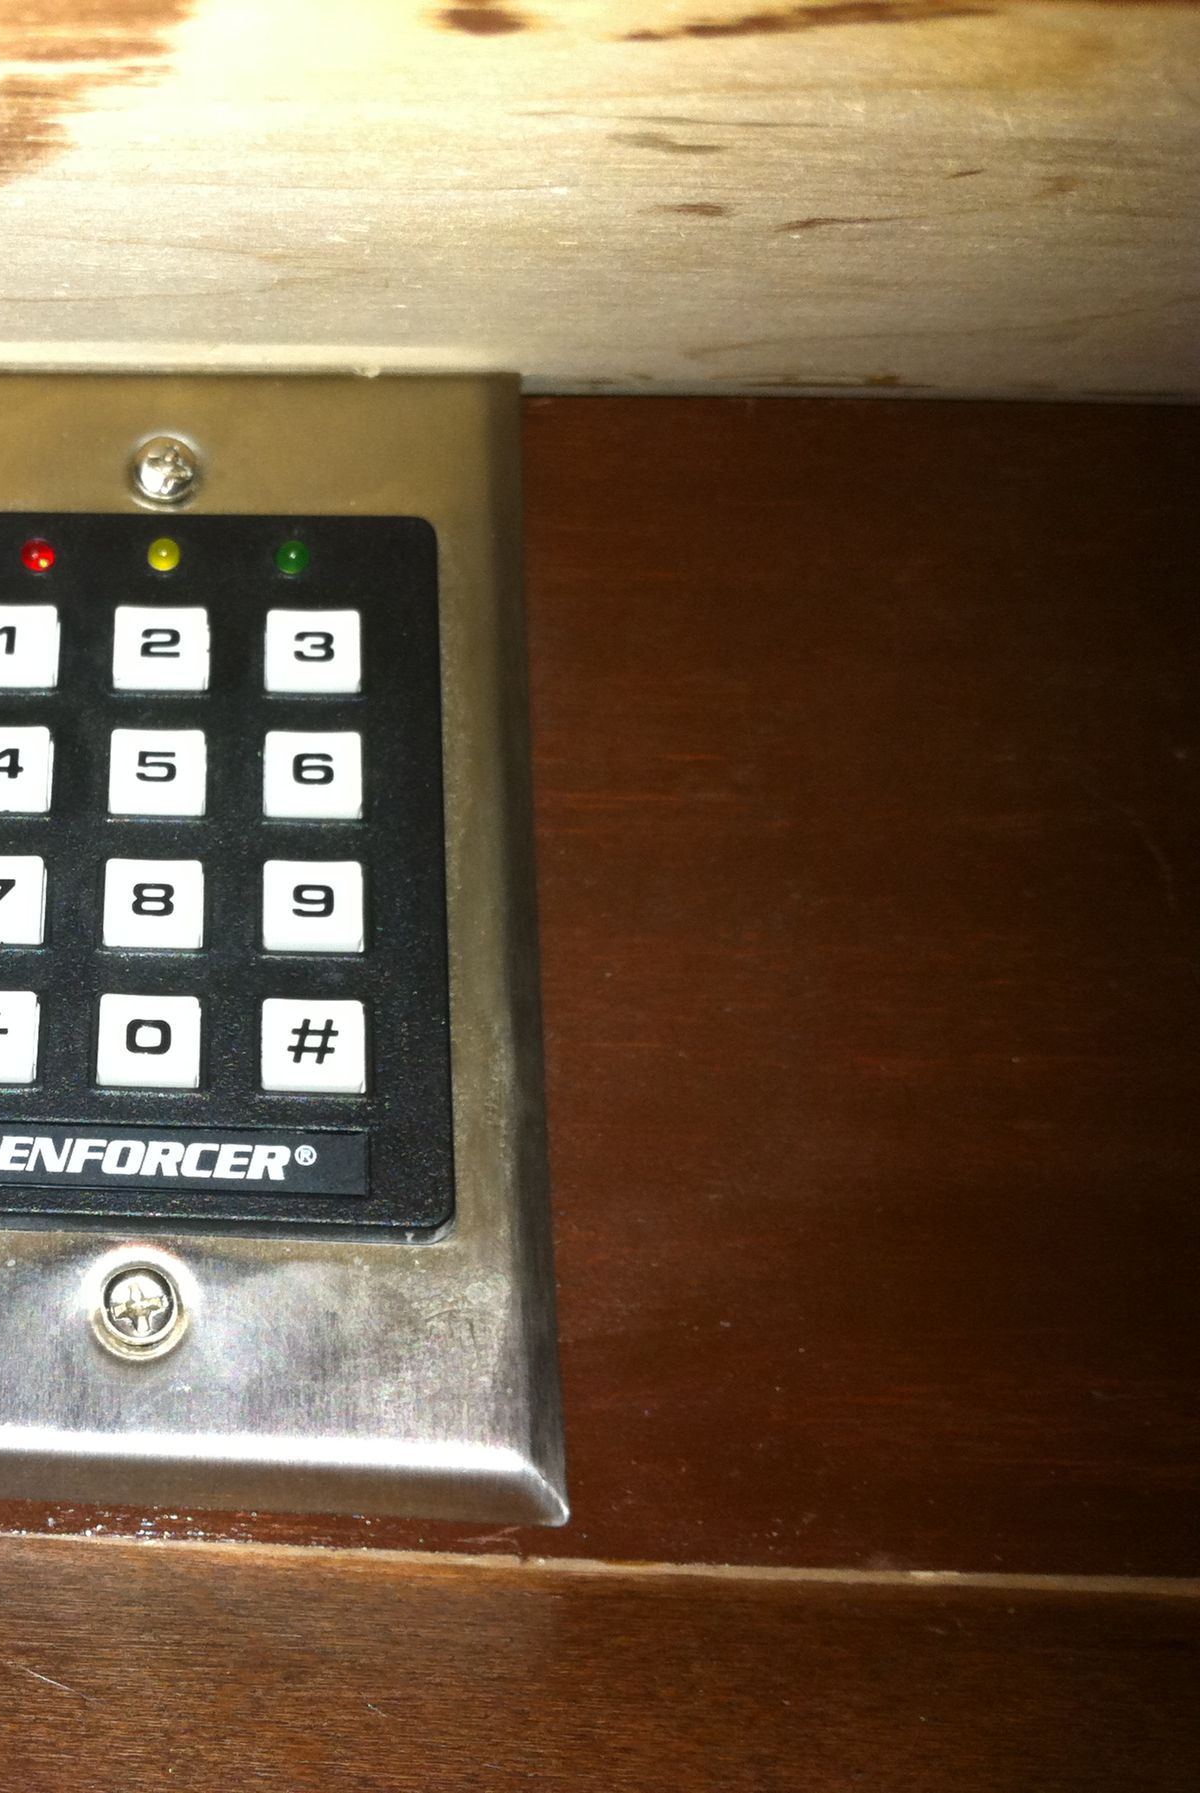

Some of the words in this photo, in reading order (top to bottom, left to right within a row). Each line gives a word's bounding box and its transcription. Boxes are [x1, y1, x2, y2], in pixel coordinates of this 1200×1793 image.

[140, 628, 180, 657] 2
[294, 631, 335, 662] 3
[136, 751, 177, 782] 5
[292, 753, 334, 785] 6
[132, 883, 174, 917] 8
[292, 884, 334, 918] 9
[287, 1018, 339, 1064] #
